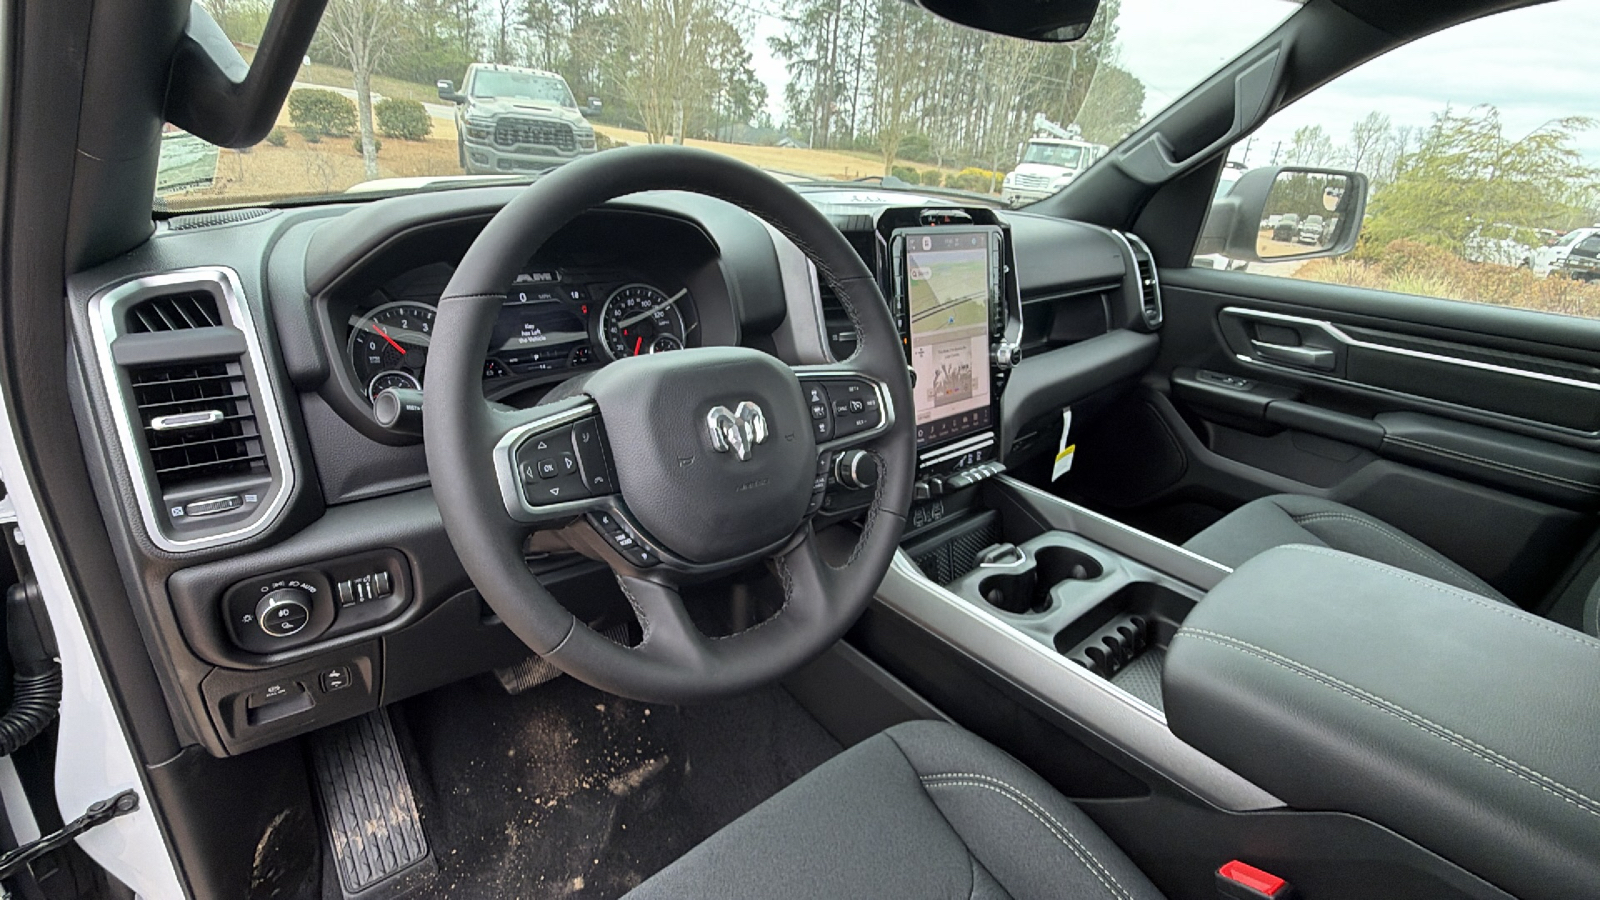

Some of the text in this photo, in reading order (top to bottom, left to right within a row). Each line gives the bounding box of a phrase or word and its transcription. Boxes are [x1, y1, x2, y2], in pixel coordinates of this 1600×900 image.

[514, 272, 552, 282] AM
[519, 292, 527, 303] 0
[401, 319, 408, 329] 2
[422, 322, 429, 332] 3
[369, 341, 376, 351] 0
[543, 464, 554, 473] OK
[300, 582, 317, 593] AUTO
